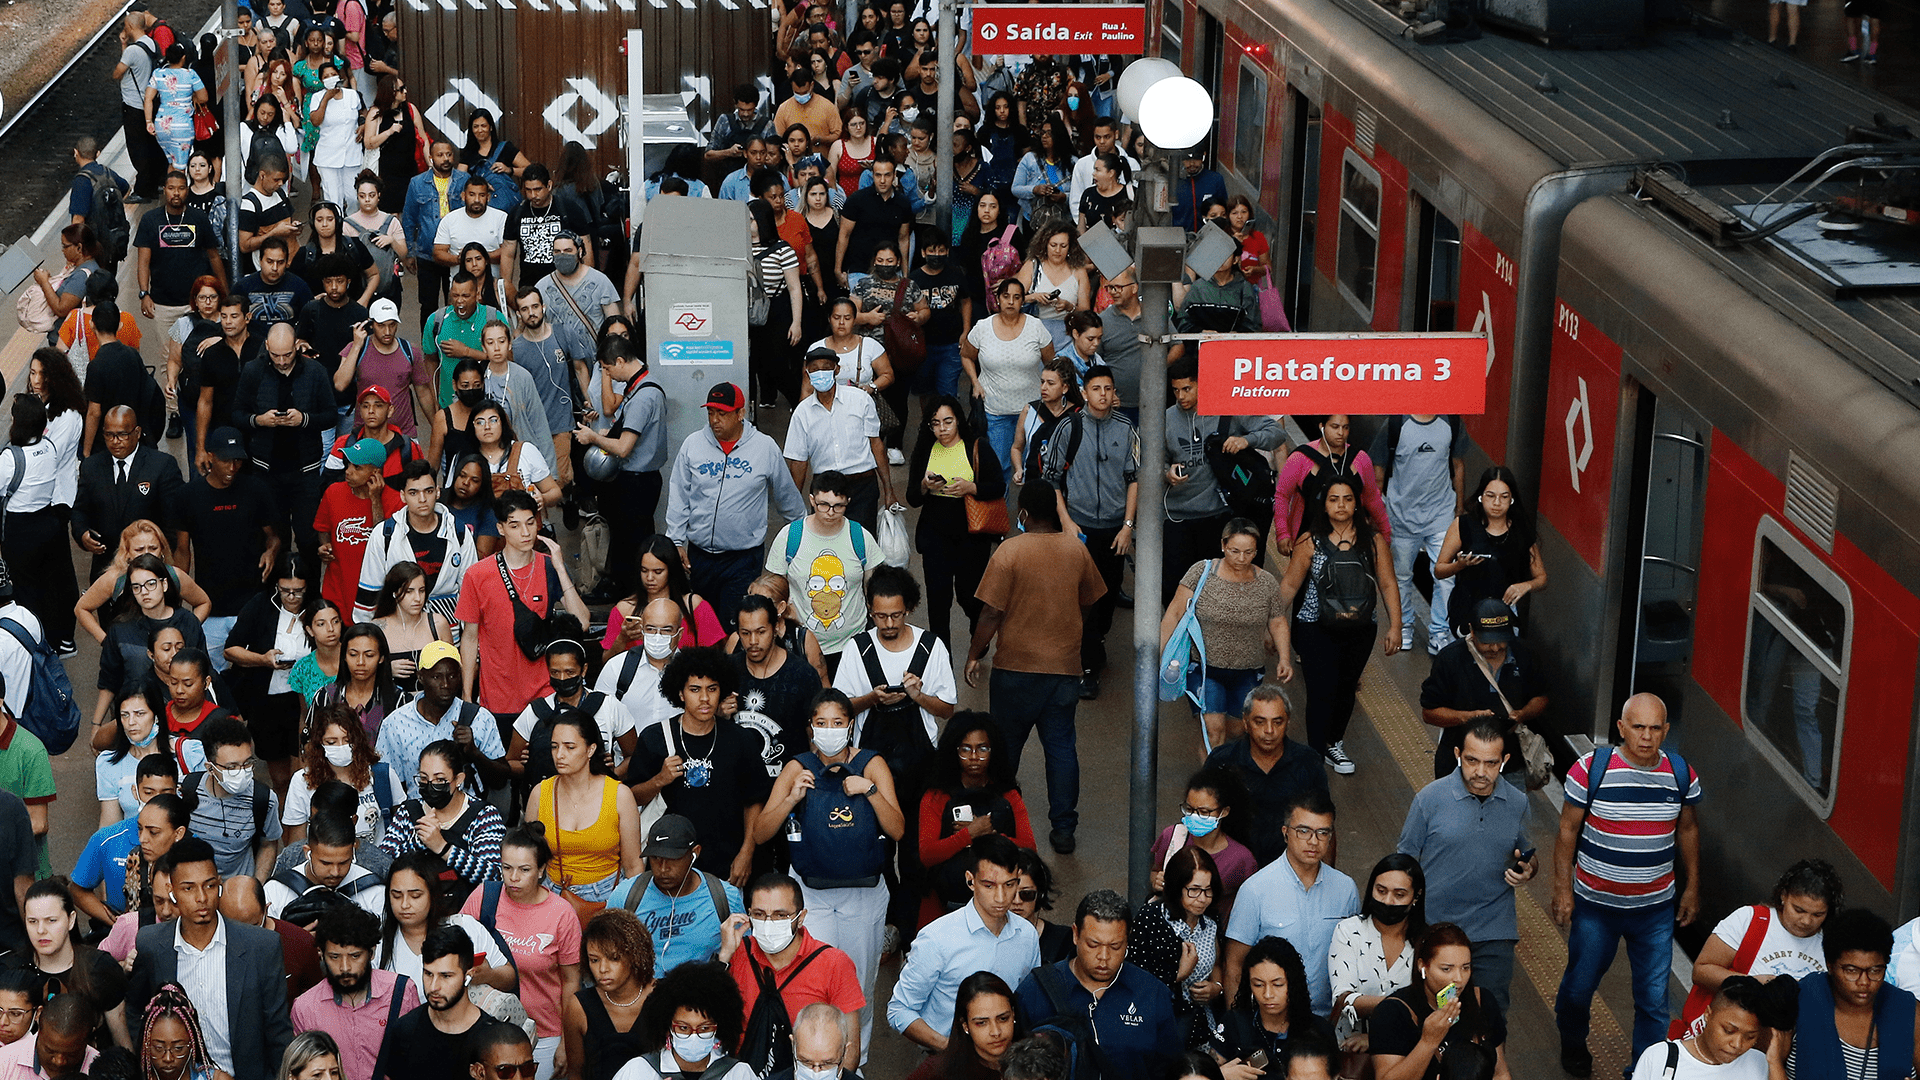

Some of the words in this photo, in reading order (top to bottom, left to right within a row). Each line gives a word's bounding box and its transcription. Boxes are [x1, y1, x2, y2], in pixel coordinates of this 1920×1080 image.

[1006, 22, 1070, 41] Saída
[1073, 31, 1093, 40] Exit
[1101, 22, 1118, 31] Rua
[1120, 23, 1127, 31] J.
[1101, 32, 1135, 40] Paulino
[1495, 252, 1513, 287] P114
[1558, 303, 1579, 341] P113
[1233, 356, 1422, 382] Plataforma
[1433, 358, 1451, 382] 3
[1231, 385, 1291, 398] Platform
[497, 561, 514, 590] LACOSTE
[1761, 950, 1793, 964] HARRY
[1119, 1014, 1144, 1023] VELAR
